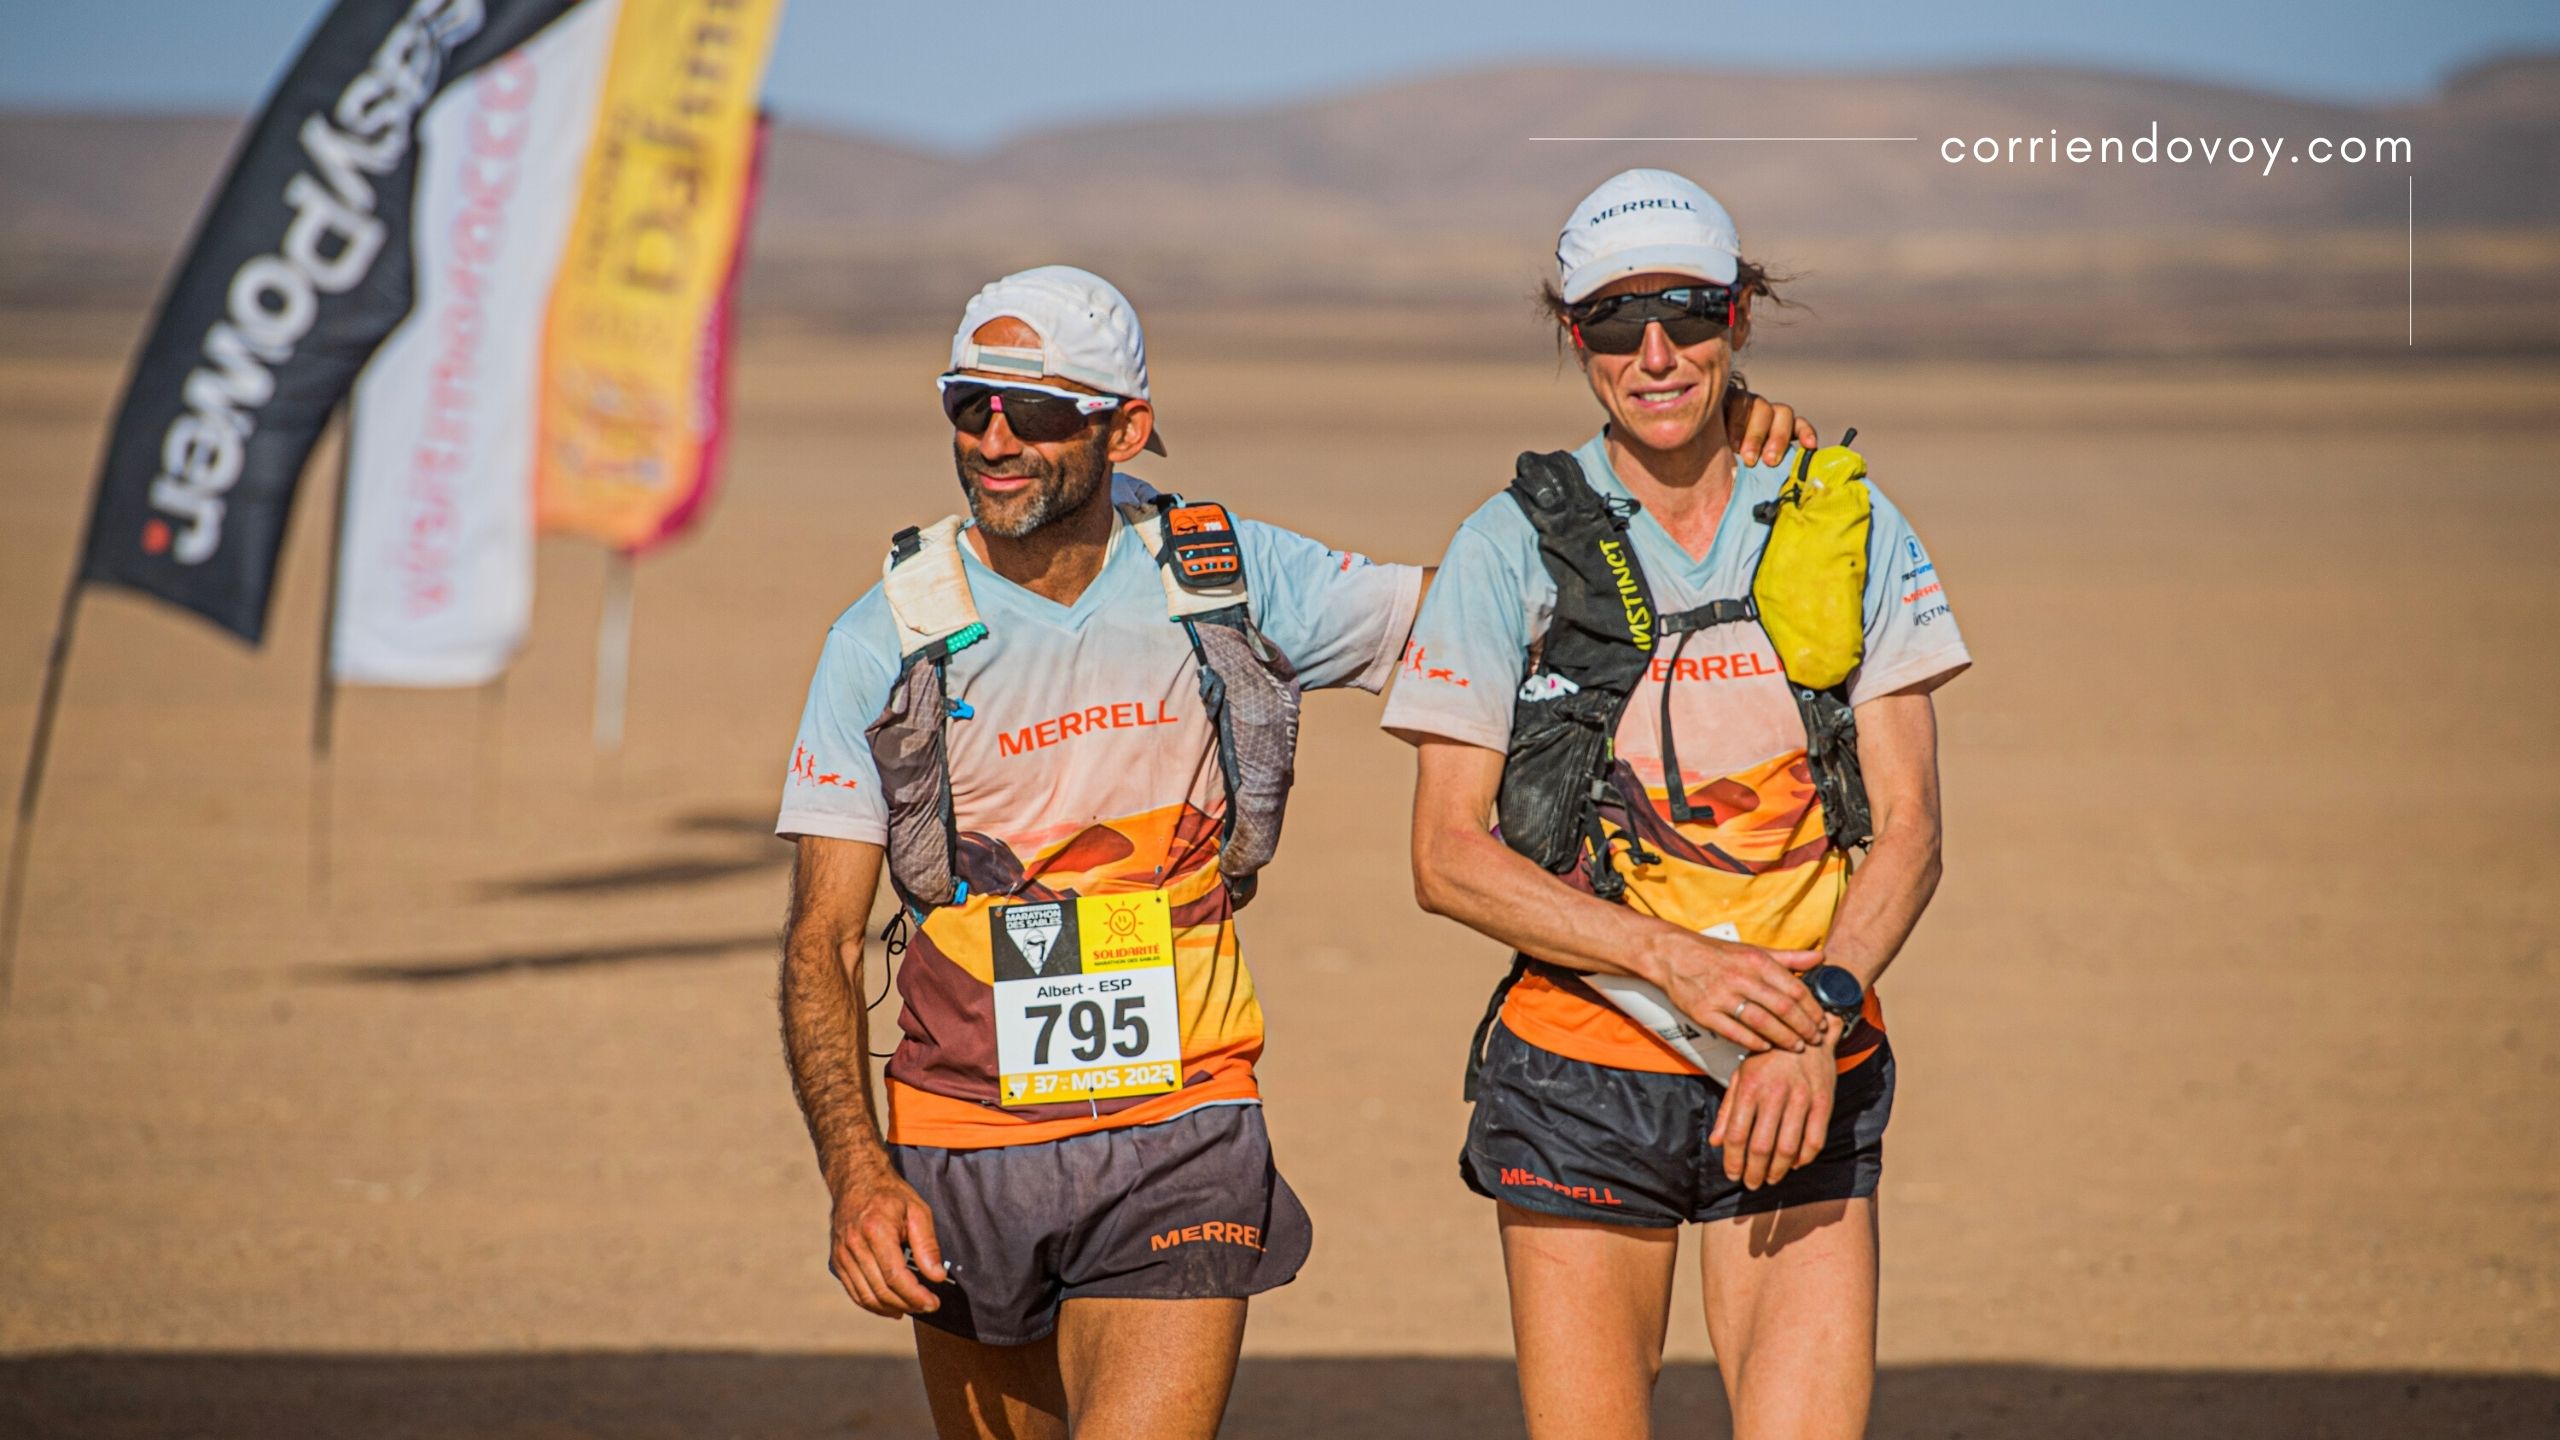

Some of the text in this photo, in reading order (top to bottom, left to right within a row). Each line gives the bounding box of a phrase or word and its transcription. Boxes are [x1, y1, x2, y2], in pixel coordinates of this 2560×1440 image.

[1590, 198, 1697, 228] MERRELL
[1645, 652, 1786, 683] ERREL
[998, 700, 1179, 758] MERRELL
[1005, 909, 1061, 921] MARATHON
[1006, 917, 1062, 930] DES SABLES
[1037, 983, 1084, 999] Albert
[1099, 978, 1132, 993] ESP
[1025, 996, 1149, 1065] 795
[1034, 1074, 1058, 1095] 37
[1071, 1069, 1120, 1091] MDS
[1124, 1064, 1175, 1087] 2023
